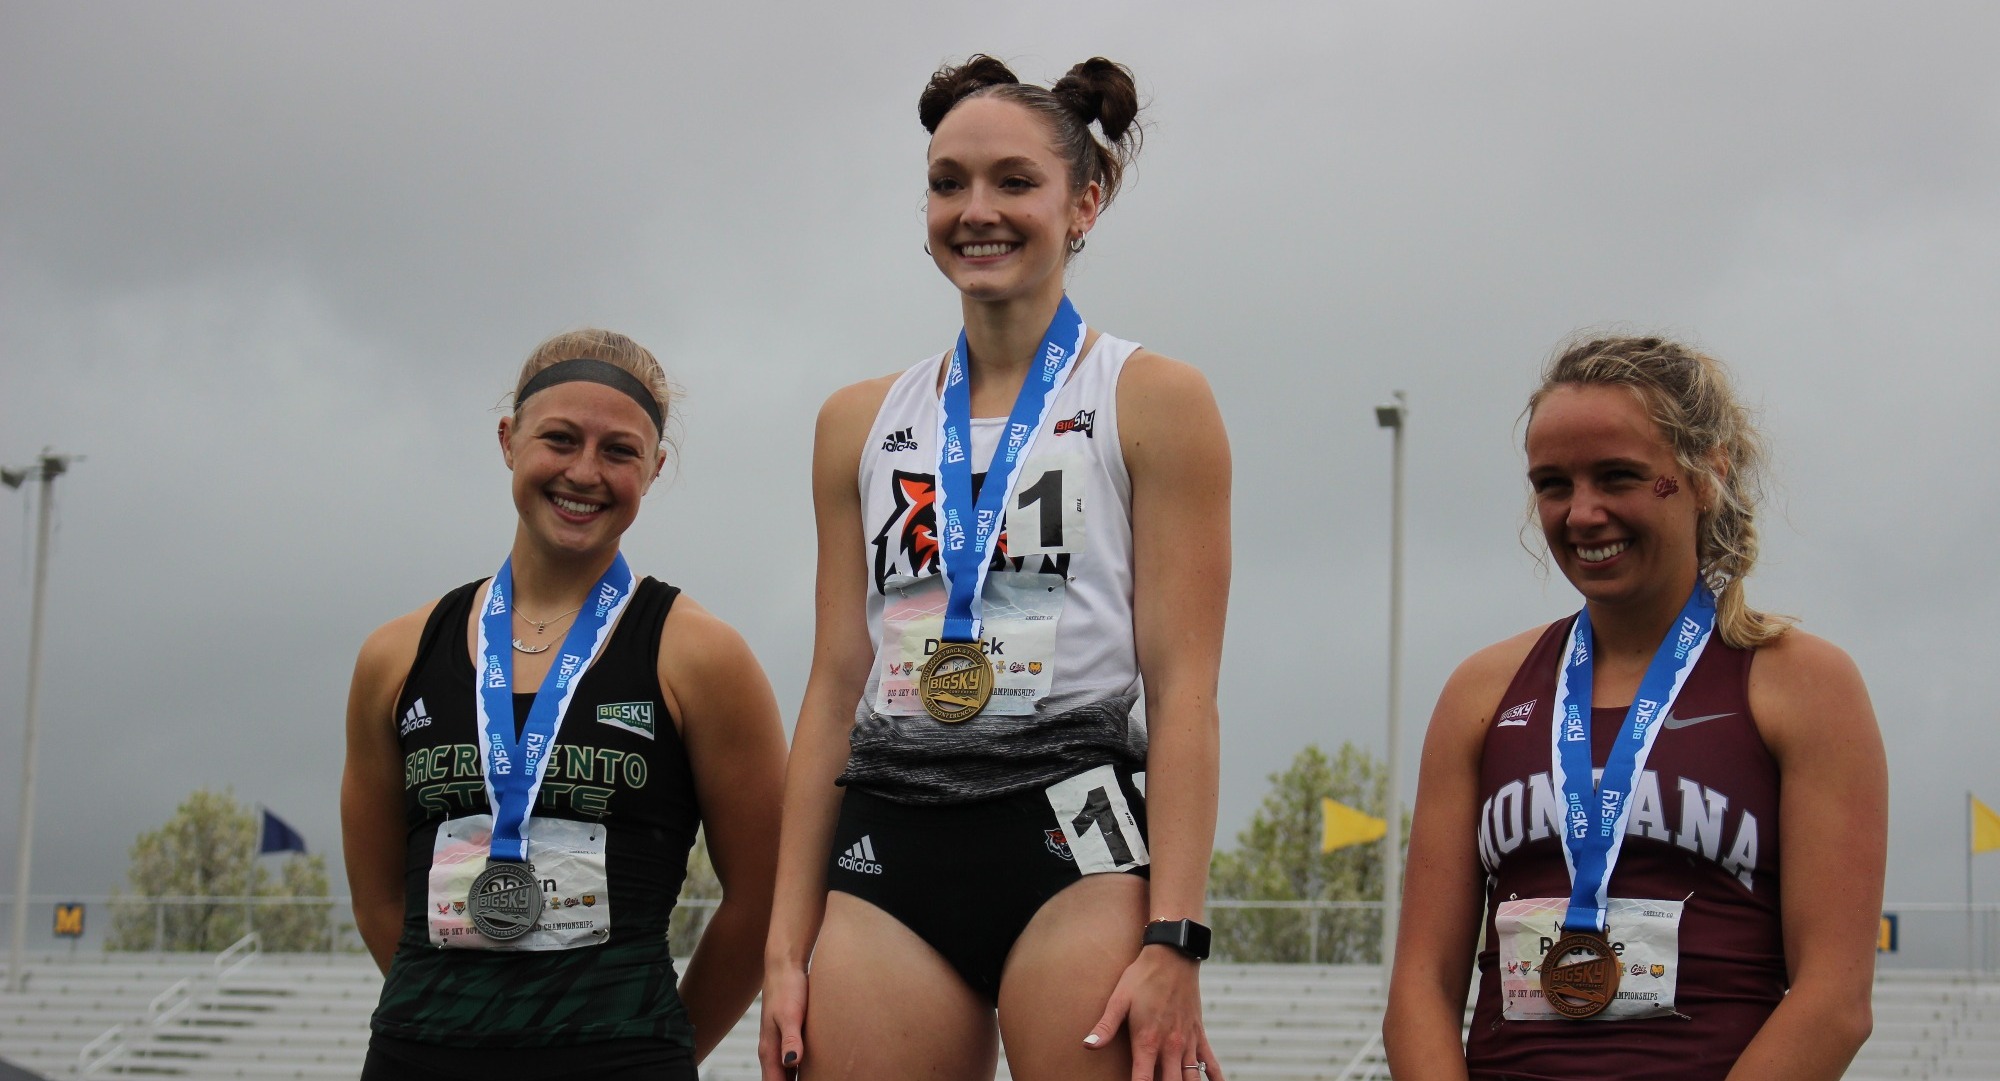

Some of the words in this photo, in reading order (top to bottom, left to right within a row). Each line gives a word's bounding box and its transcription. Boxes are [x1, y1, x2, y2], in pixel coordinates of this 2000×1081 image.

[1042, 341, 1065, 383] BIGSKY
[947, 426, 965, 464] BIGSKY
[1006, 423, 1028, 463] BIGSKY
[1018, 469, 1063, 548] 1
[948, 508, 966, 551] BIGSKY
[975, 509, 994, 553] BIGSKY
[595, 582, 619, 618] BIGSKY
[1674, 616, 1700, 660] BIGSKY
[489, 654, 507, 689] BIGSKY
[556, 653, 581, 689] BIGSKY
[930, 668, 981, 690] BIGSKY
[600, 704, 651, 724] BIGSKY
[1567, 704, 1586, 742] BIGSKY
[1632, 698, 1657, 740] BIGSKY
[405, 743, 648, 790] SACRENTO
[491, 733, 512, 775] BIGSKY
[525, 732, 545, 776] BIGSKY
[418, 781, 616, 820] STTE
[1569, 792, 1589, 839] BIGSKY
[1601, 789, 1621, 838] BIGSKY
[1071, 785, 1136, 868] 1
[1477, 766, 1759, 893] MONANA
[838, 856, 883, 875] adidas
[480, 886, 529, 909] BIGSKY
[55, 905, 84, 935] M
[1552, 962, 1605, 984] BIGSKY
